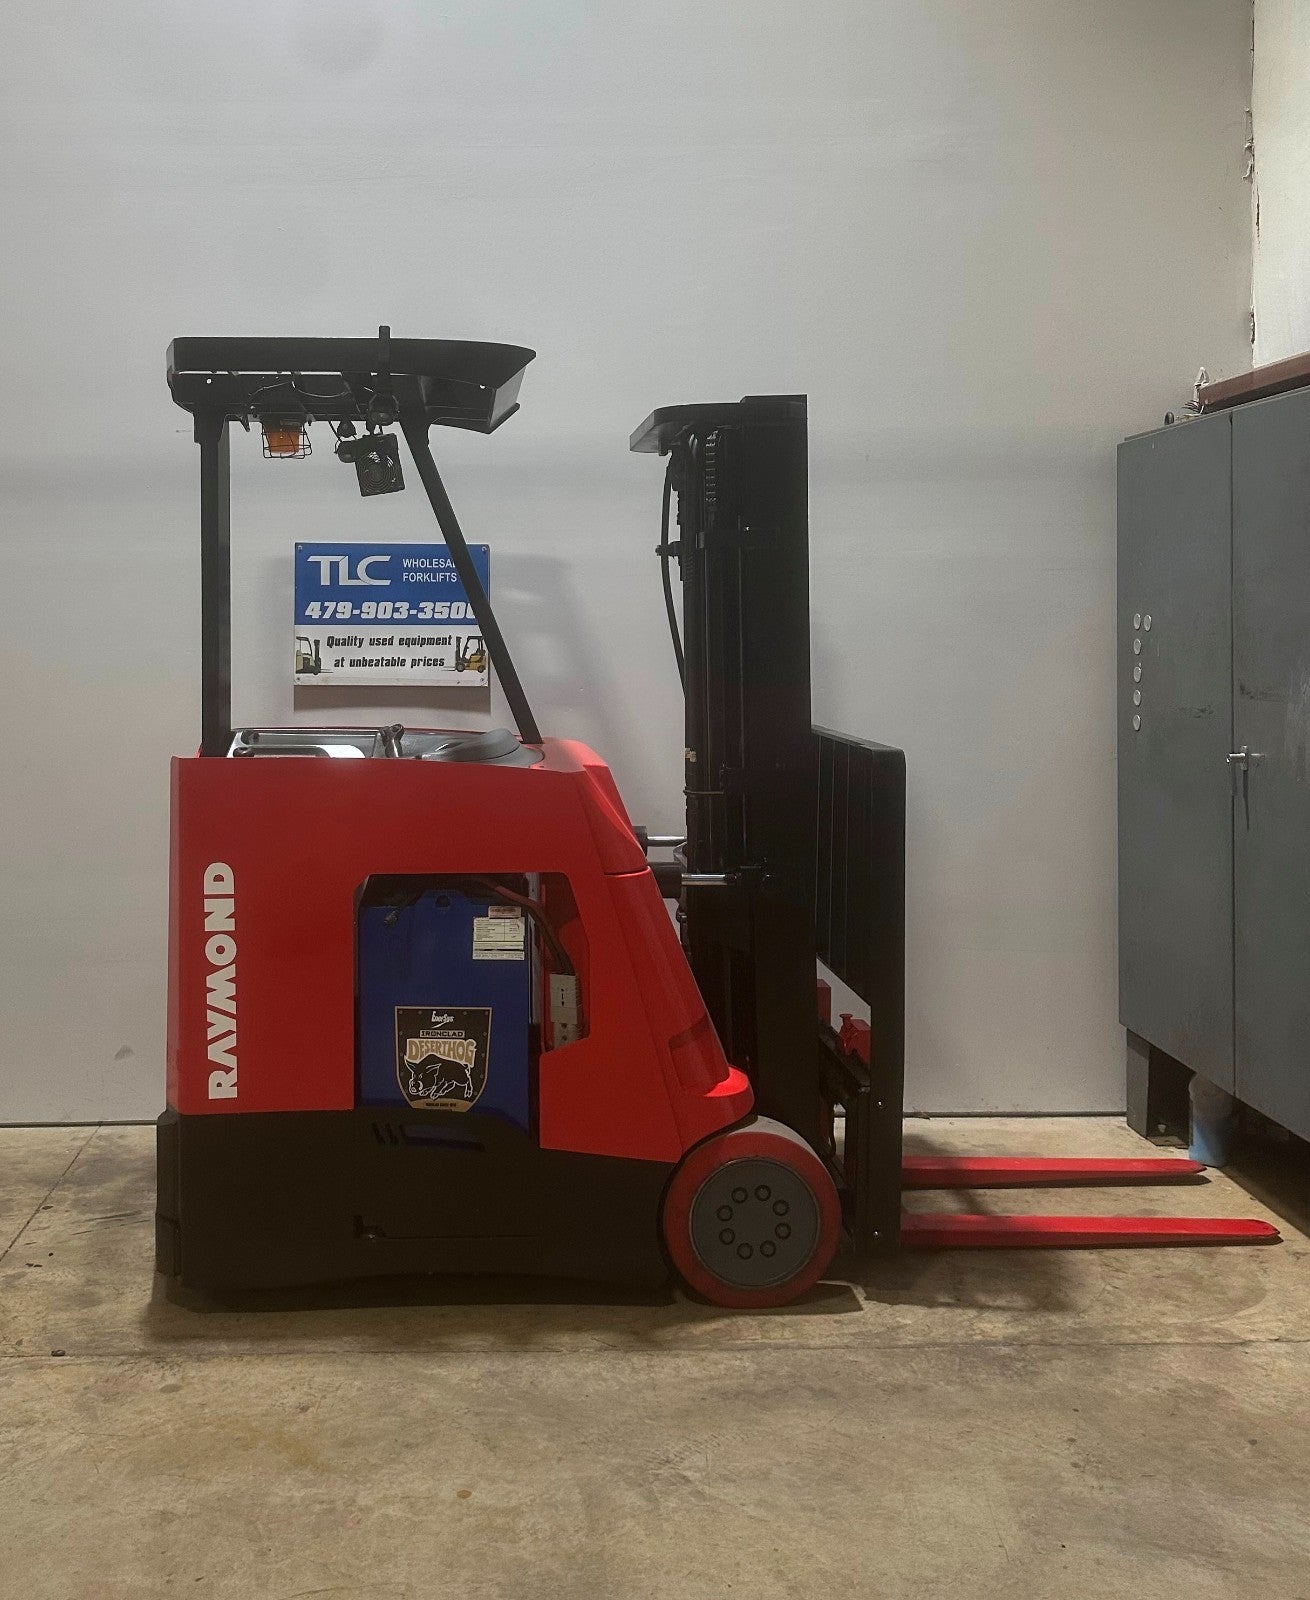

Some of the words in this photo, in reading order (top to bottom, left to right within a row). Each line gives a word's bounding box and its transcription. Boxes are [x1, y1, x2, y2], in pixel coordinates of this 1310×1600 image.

[402, 558, 456, 568] WHOLESA
[307, 555, 391, 586] TLC
[402, 572, 458, 582] FORKLIFTS
[326, 635, 365, 649] Quality
[369, 635, 394, 646] used
[398, 634, 453, 648] equipment
[334, 657, 345, 668] at
[349, 656, 406, 668] unbeatable
[410, 656, 445, 669] prices
[203, 862, 238, 1100] RAYMOND
[421, 1030, 464, 1038] IRONCLAD
